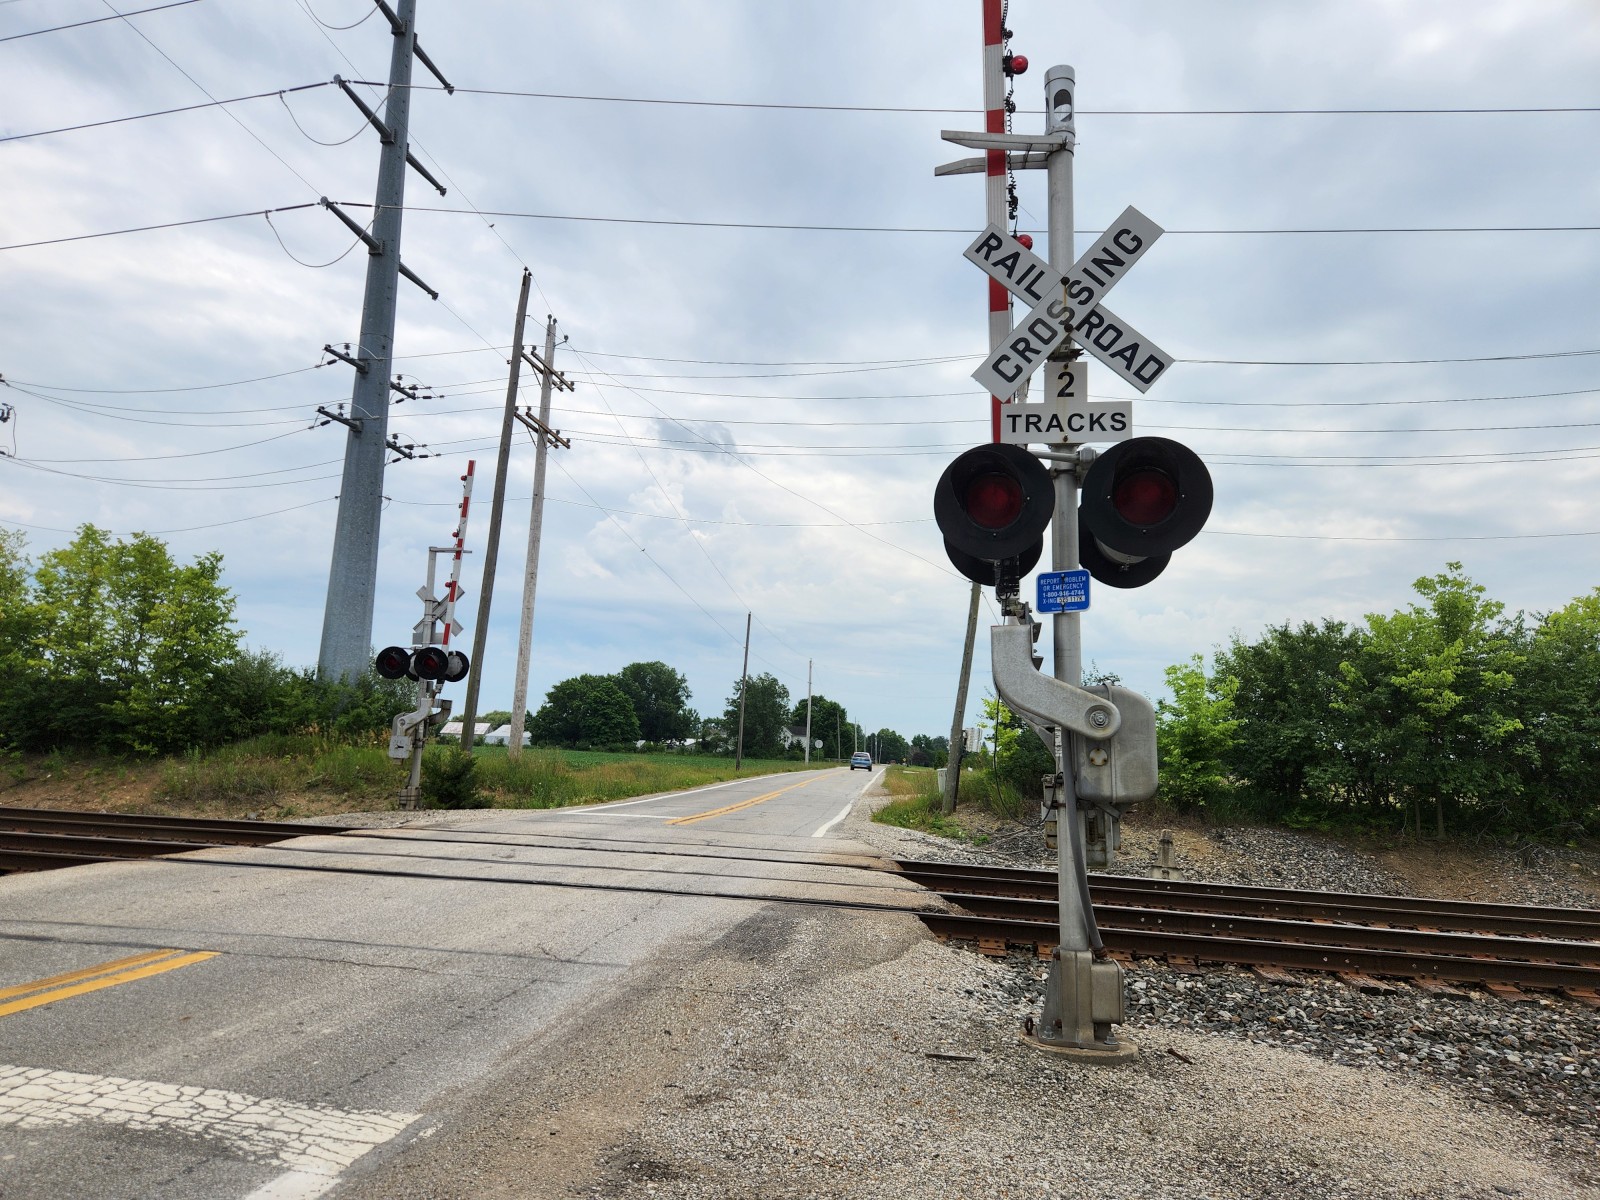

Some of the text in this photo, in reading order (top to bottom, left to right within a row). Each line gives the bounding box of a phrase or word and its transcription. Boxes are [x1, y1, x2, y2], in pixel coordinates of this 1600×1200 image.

[975, 232, 1165, 384] RAIL ROAD
[992, 228, 1143, 383] CROSSING
[1006, 412, 1127, 433] TRACKS
[1057, 371, 1075, 398] 2
